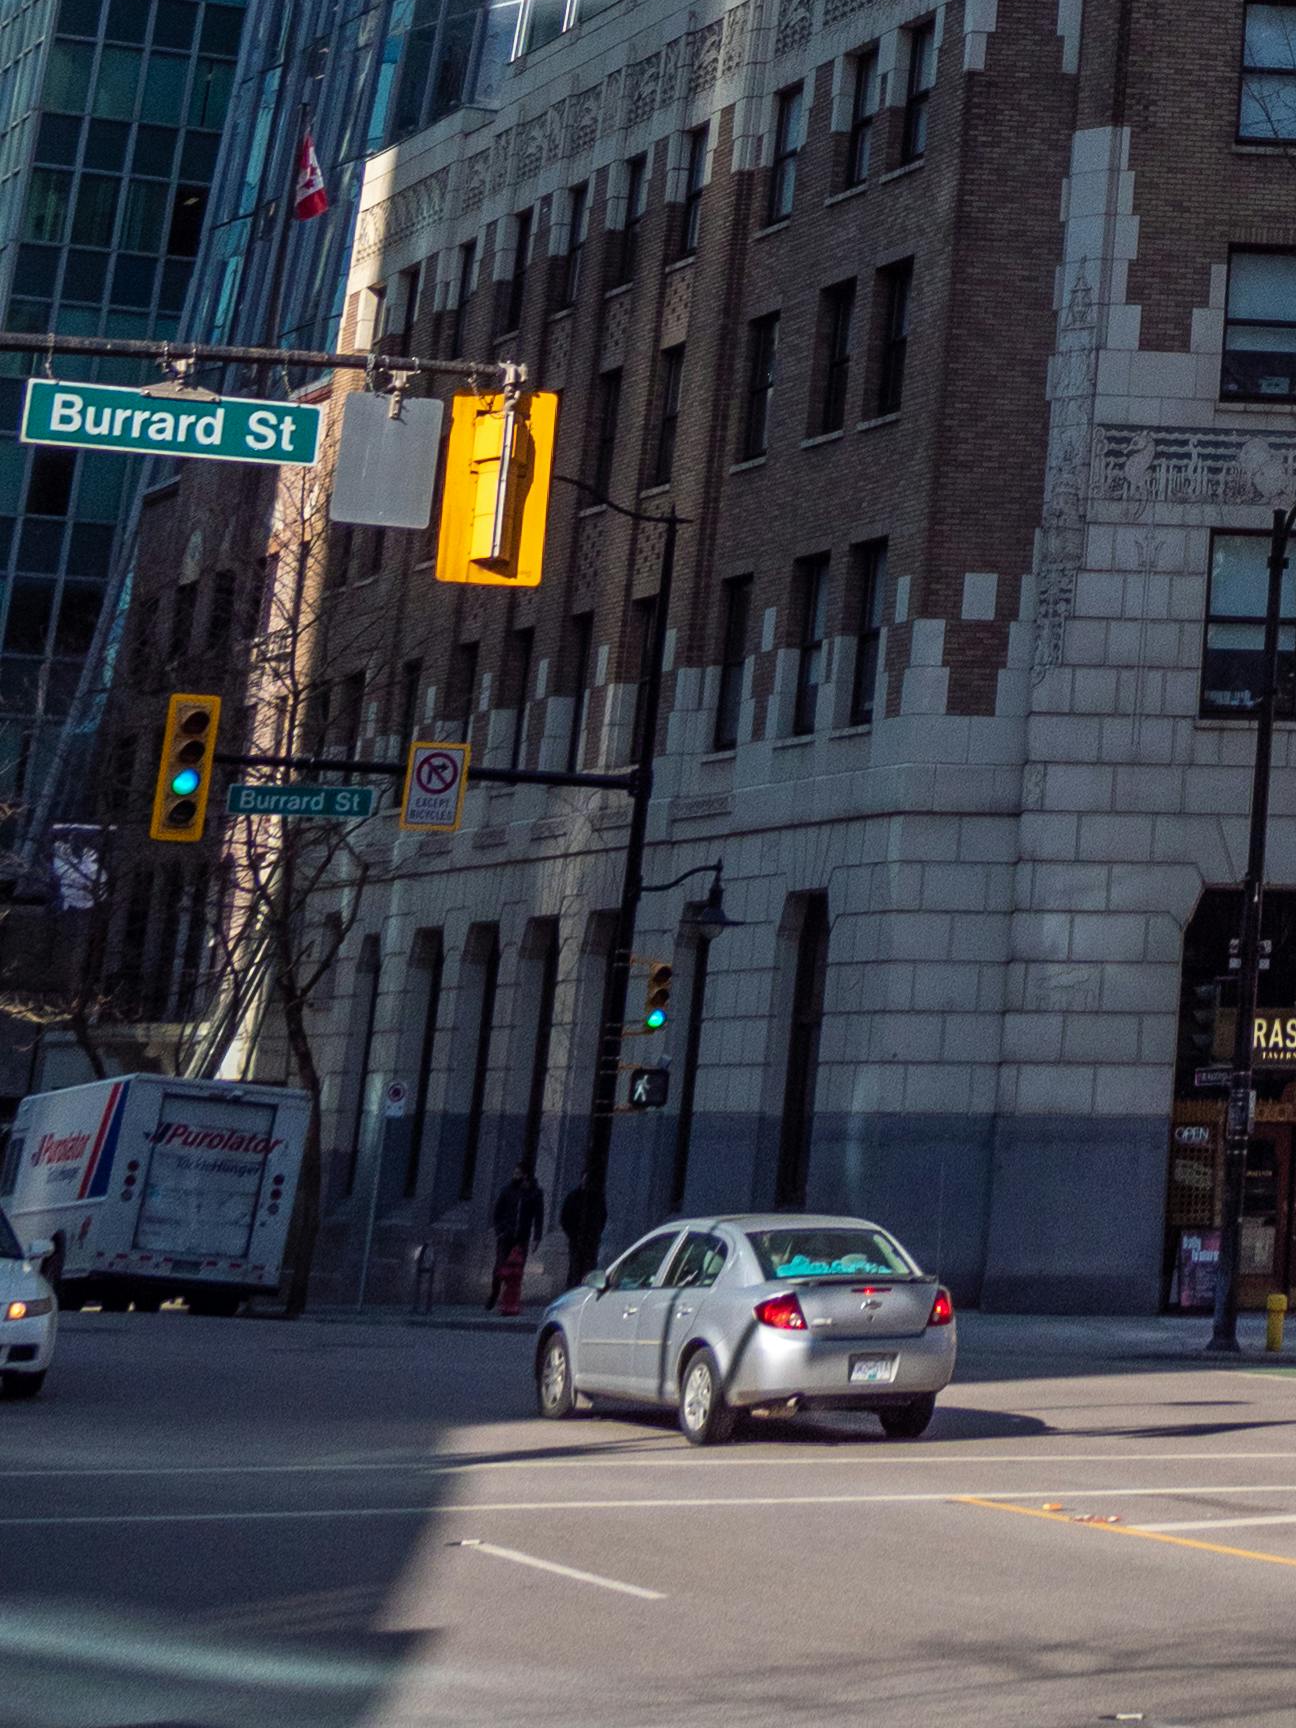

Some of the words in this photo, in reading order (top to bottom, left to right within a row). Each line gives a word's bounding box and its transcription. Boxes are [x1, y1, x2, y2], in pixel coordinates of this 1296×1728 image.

[50, 393, 225, 445] Burrard
[246, 410, 296, 452] St
[240, 790, 325, 812] Burrard
[335, 792, 361, 812] St
[414, 797, 450, 809] EXCEPT
[409, 808, 452, 820] BICYCLES
[164, 1122, 284, 1155] Purolator
[1175, 1126, 1209, 1142] OPEN
